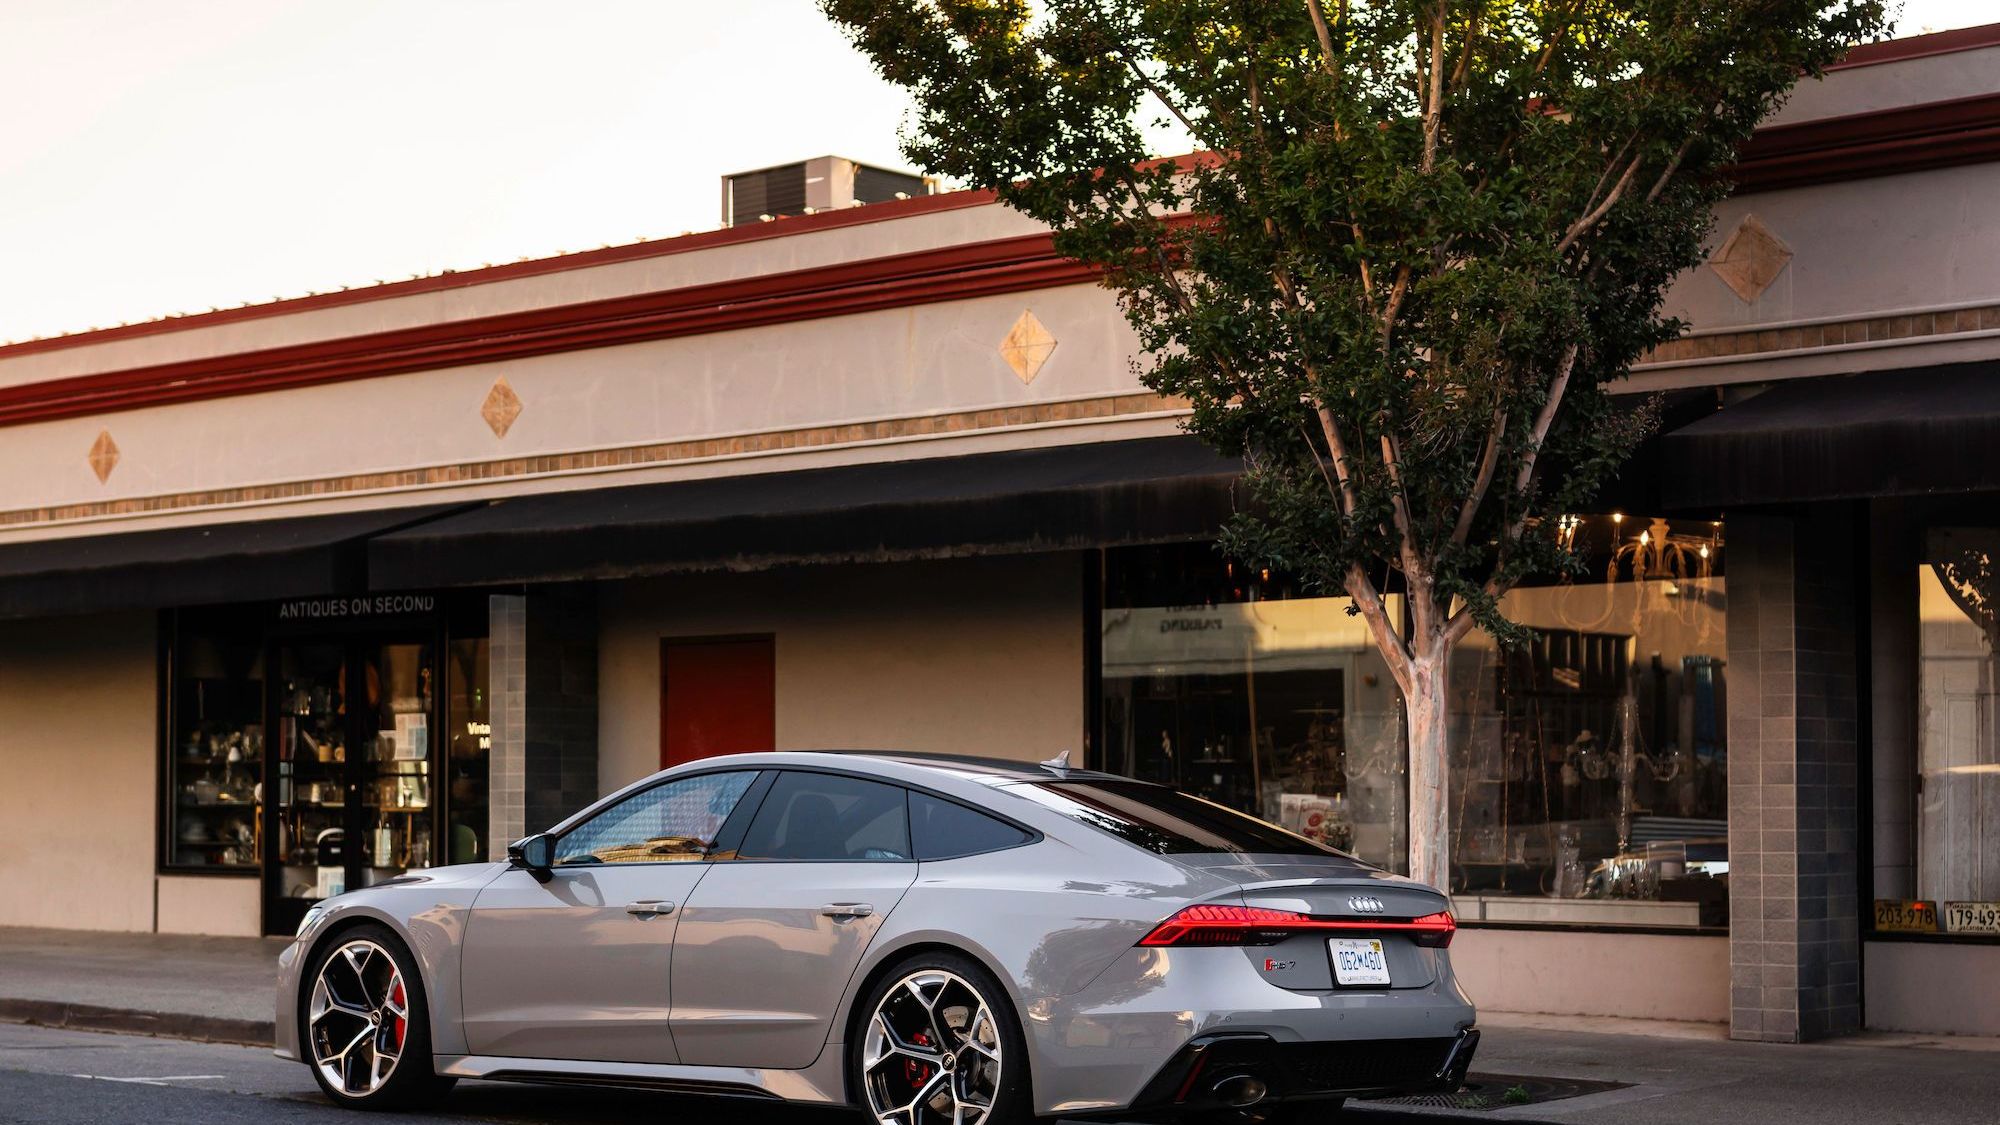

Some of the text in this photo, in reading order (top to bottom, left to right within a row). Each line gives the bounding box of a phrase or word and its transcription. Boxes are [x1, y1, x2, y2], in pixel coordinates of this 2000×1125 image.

[279, 595, 435, 618] ANTIQUES ON SECOND
[1339, 951, 1382, 971] 062M460
